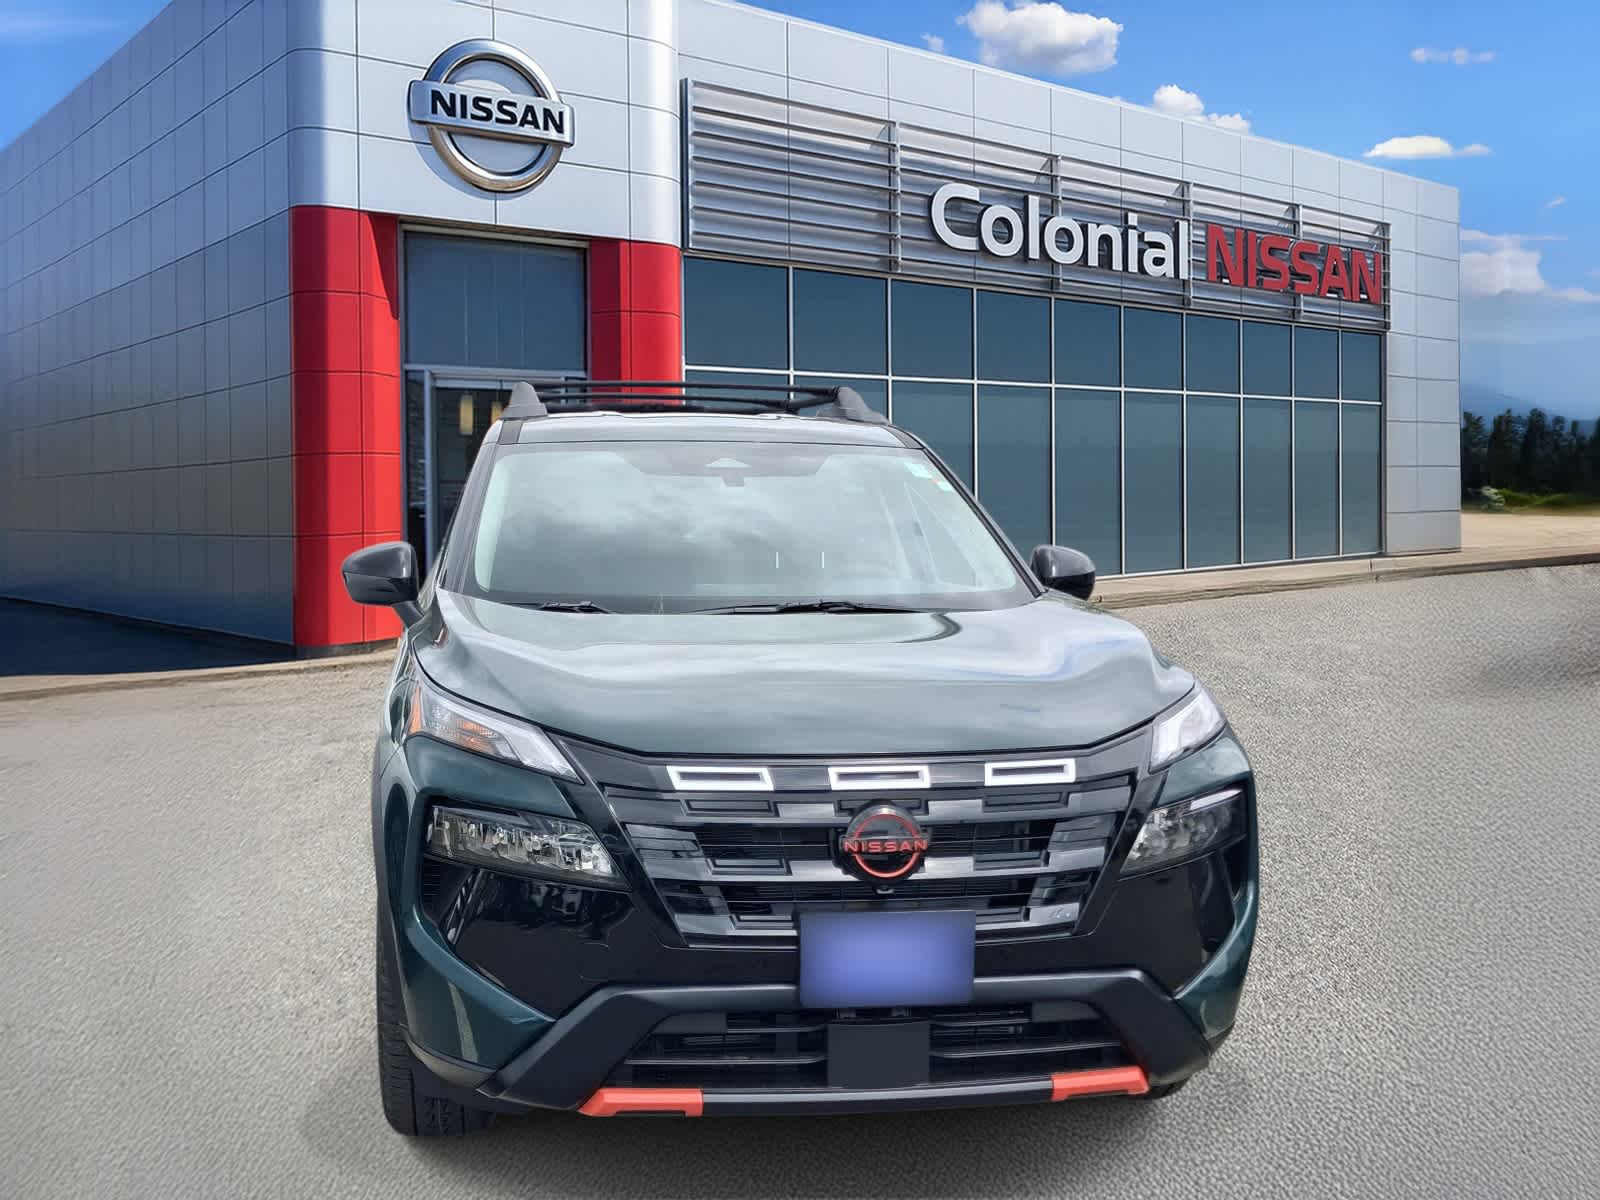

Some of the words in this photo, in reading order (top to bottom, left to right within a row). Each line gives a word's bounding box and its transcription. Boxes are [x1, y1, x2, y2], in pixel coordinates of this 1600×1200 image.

[431, 89, 565, 134] NISSAN
[929, 182, 1190, 280] Colonial
[1206, 223, 1382, 305] NISSAN
[843, 839, 929, 853] NISSAN
